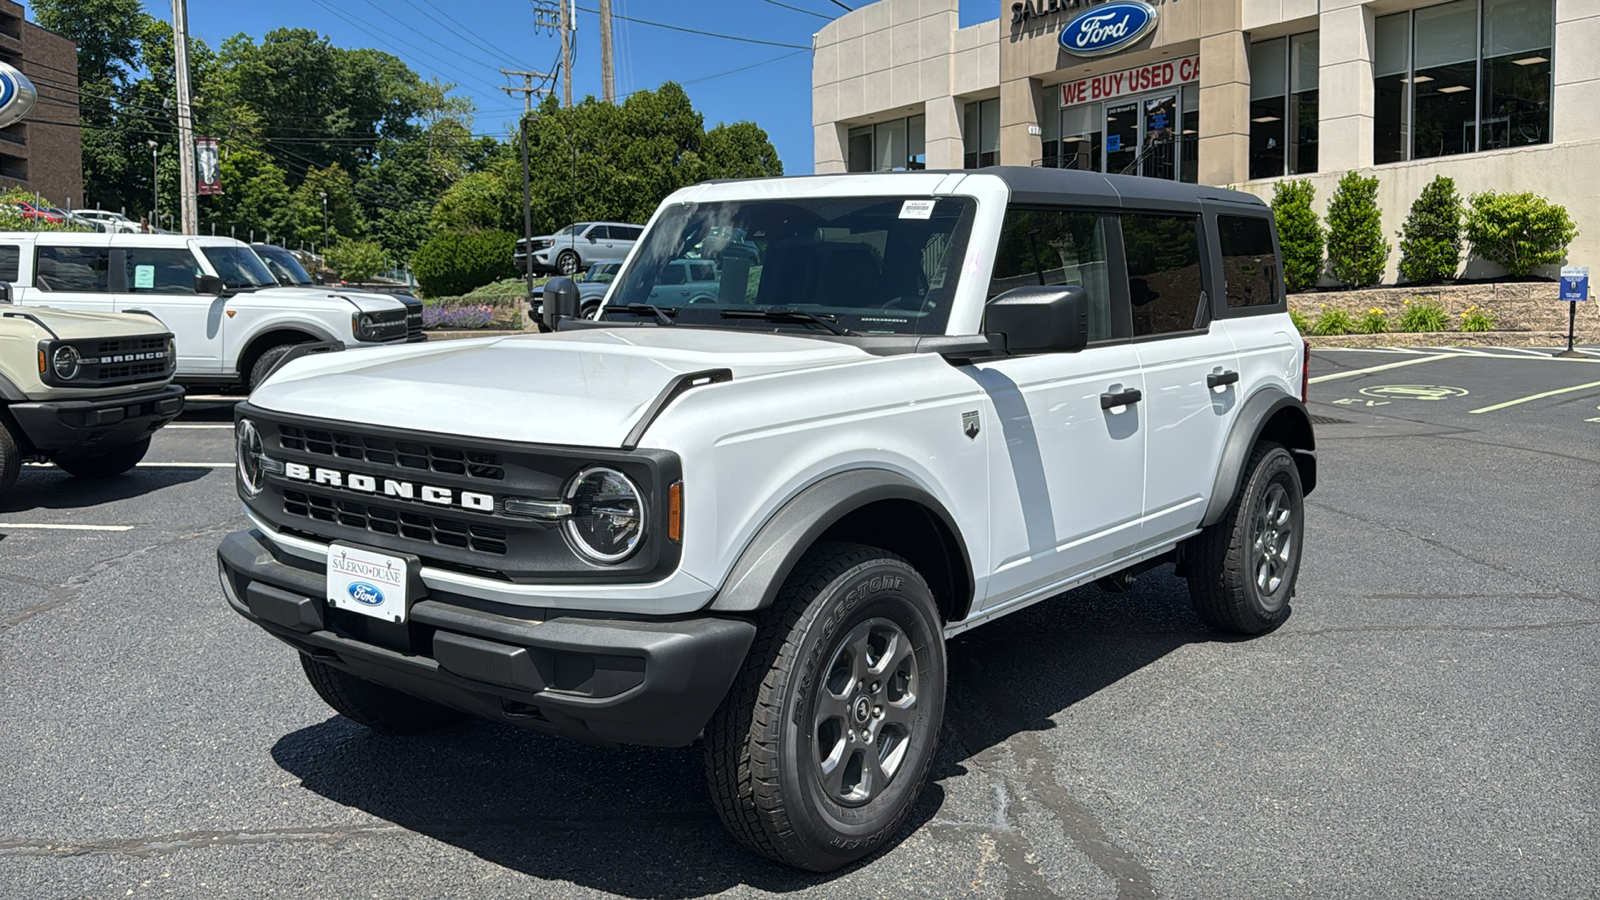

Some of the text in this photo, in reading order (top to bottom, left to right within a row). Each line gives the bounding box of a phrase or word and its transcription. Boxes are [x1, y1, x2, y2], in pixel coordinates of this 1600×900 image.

[1075, 11, 1131, 48] Ford
[1062, 80, 1087, 105] WE
[1091, 72, 1124, 99] BUY
[1128, 63, 1174, 93] USED
[101, 351, 164, 364] BRONCO
[285, 462, 494, 512] BRONCO
[332, 558, 401, 584] SALERNO DUANE
[354, 584, 378, 604] Ford
